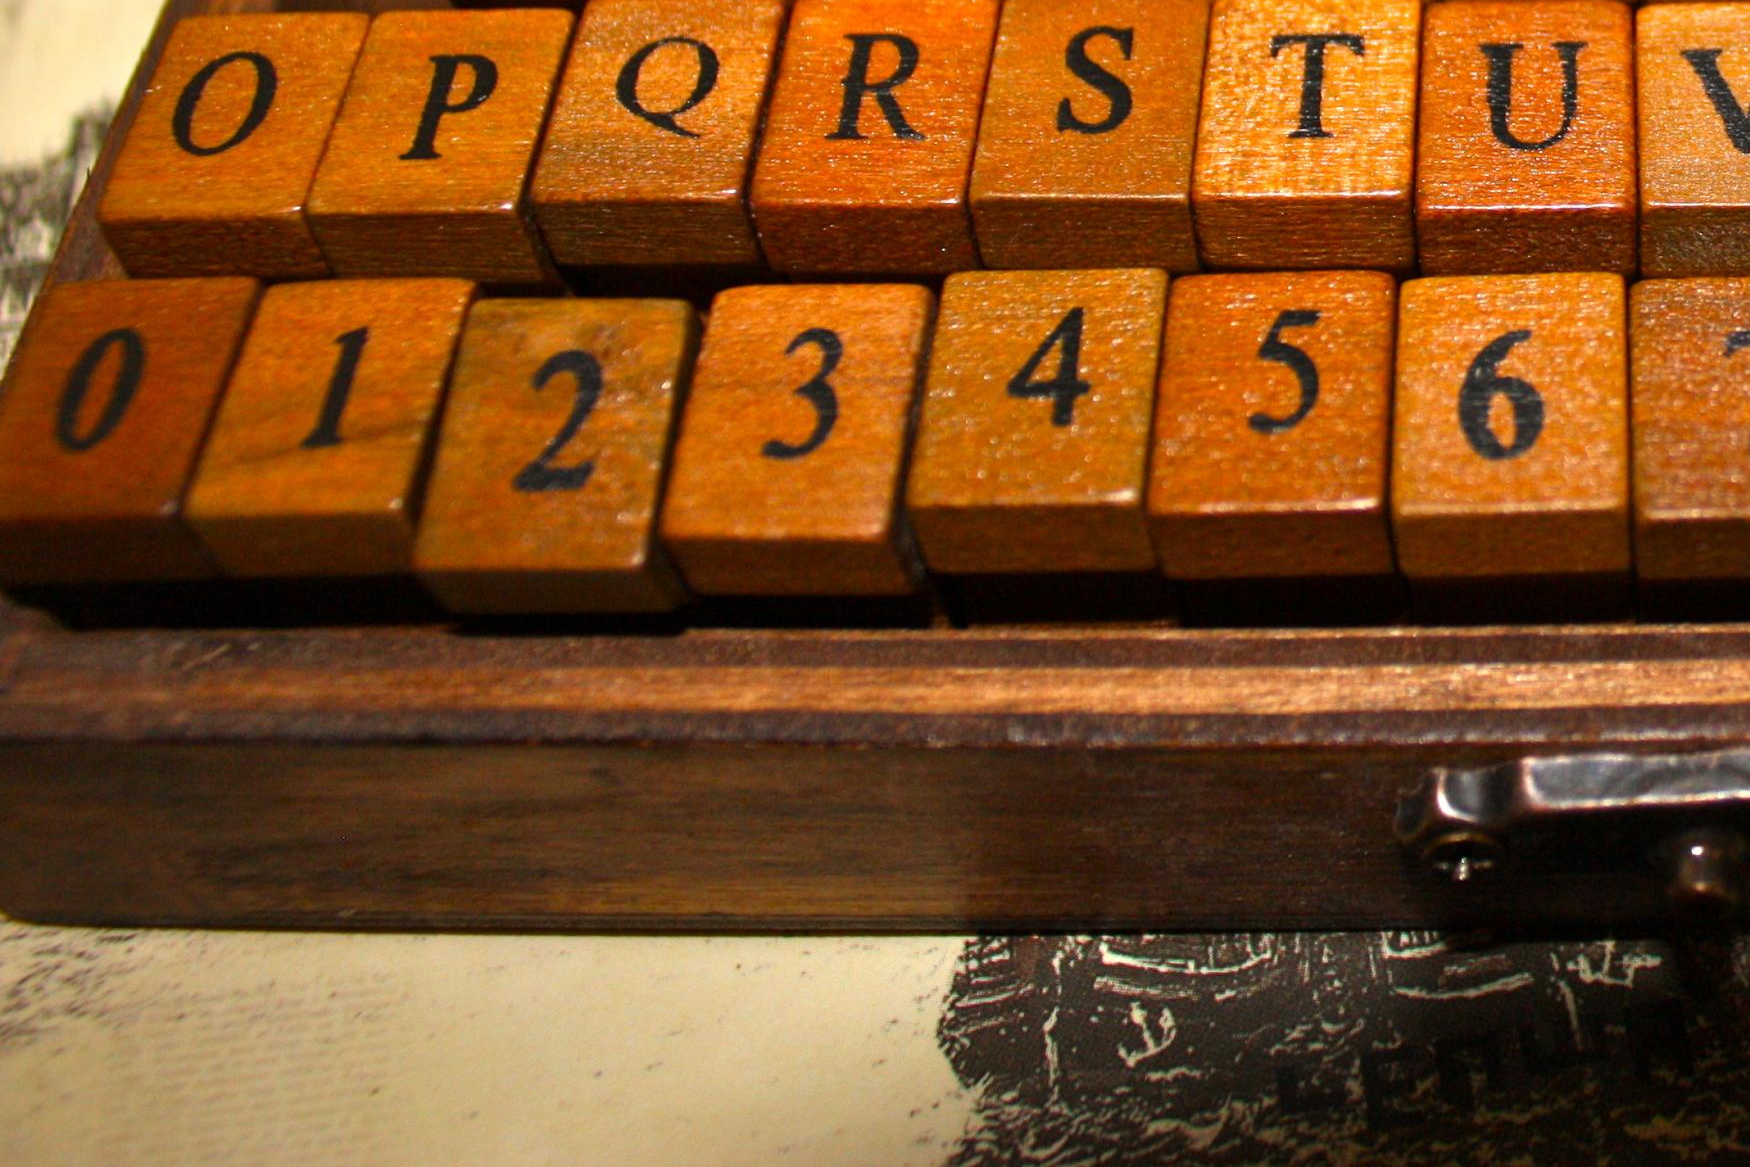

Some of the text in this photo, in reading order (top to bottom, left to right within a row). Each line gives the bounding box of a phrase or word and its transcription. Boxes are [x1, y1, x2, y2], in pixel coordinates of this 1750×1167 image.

[171, 51, 278, 157] O
[398, 54, 499, 161] P
[615, 35, 720, 139] Q
[824, 33, 926, 141] R
[1056, 25, 1134, 135] S
[1270, 32, 1366, 139] T
[1479, 41, 1587, 152] U
[299, 326, 369, 451] 1
[512, 349, 605, 493] 2
[761, 327, 843, 461] 3
[1006, 307, 1092, 428] 4
[1248, 309, 1321, 435] 5
[1458, 329, 1545, 461] 6
